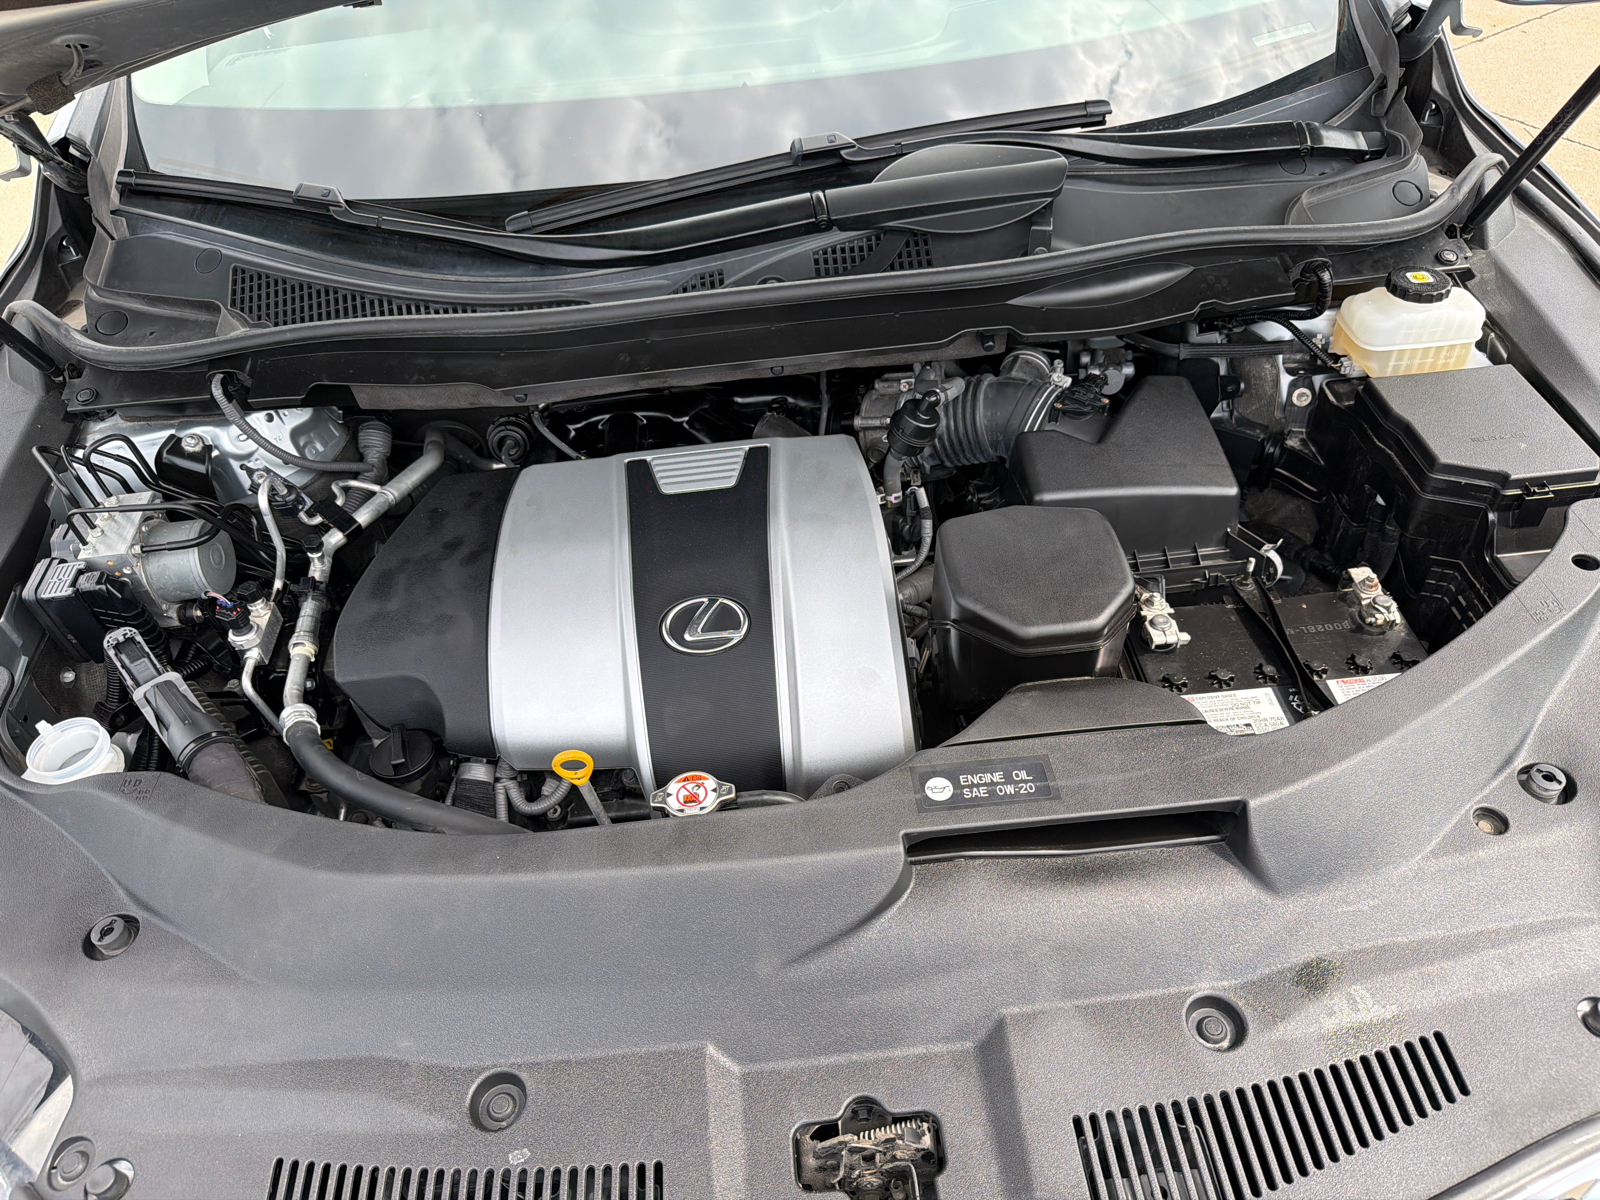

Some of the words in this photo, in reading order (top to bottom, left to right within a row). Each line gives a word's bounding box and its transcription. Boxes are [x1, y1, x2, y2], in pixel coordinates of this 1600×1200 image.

[960, 771, 1005, 785] ENGINE
[1012, 770, 1033, 781] OIL
[963, 786, 989, 798] SAE
[996, 783, 1036, 796] 0W-20
